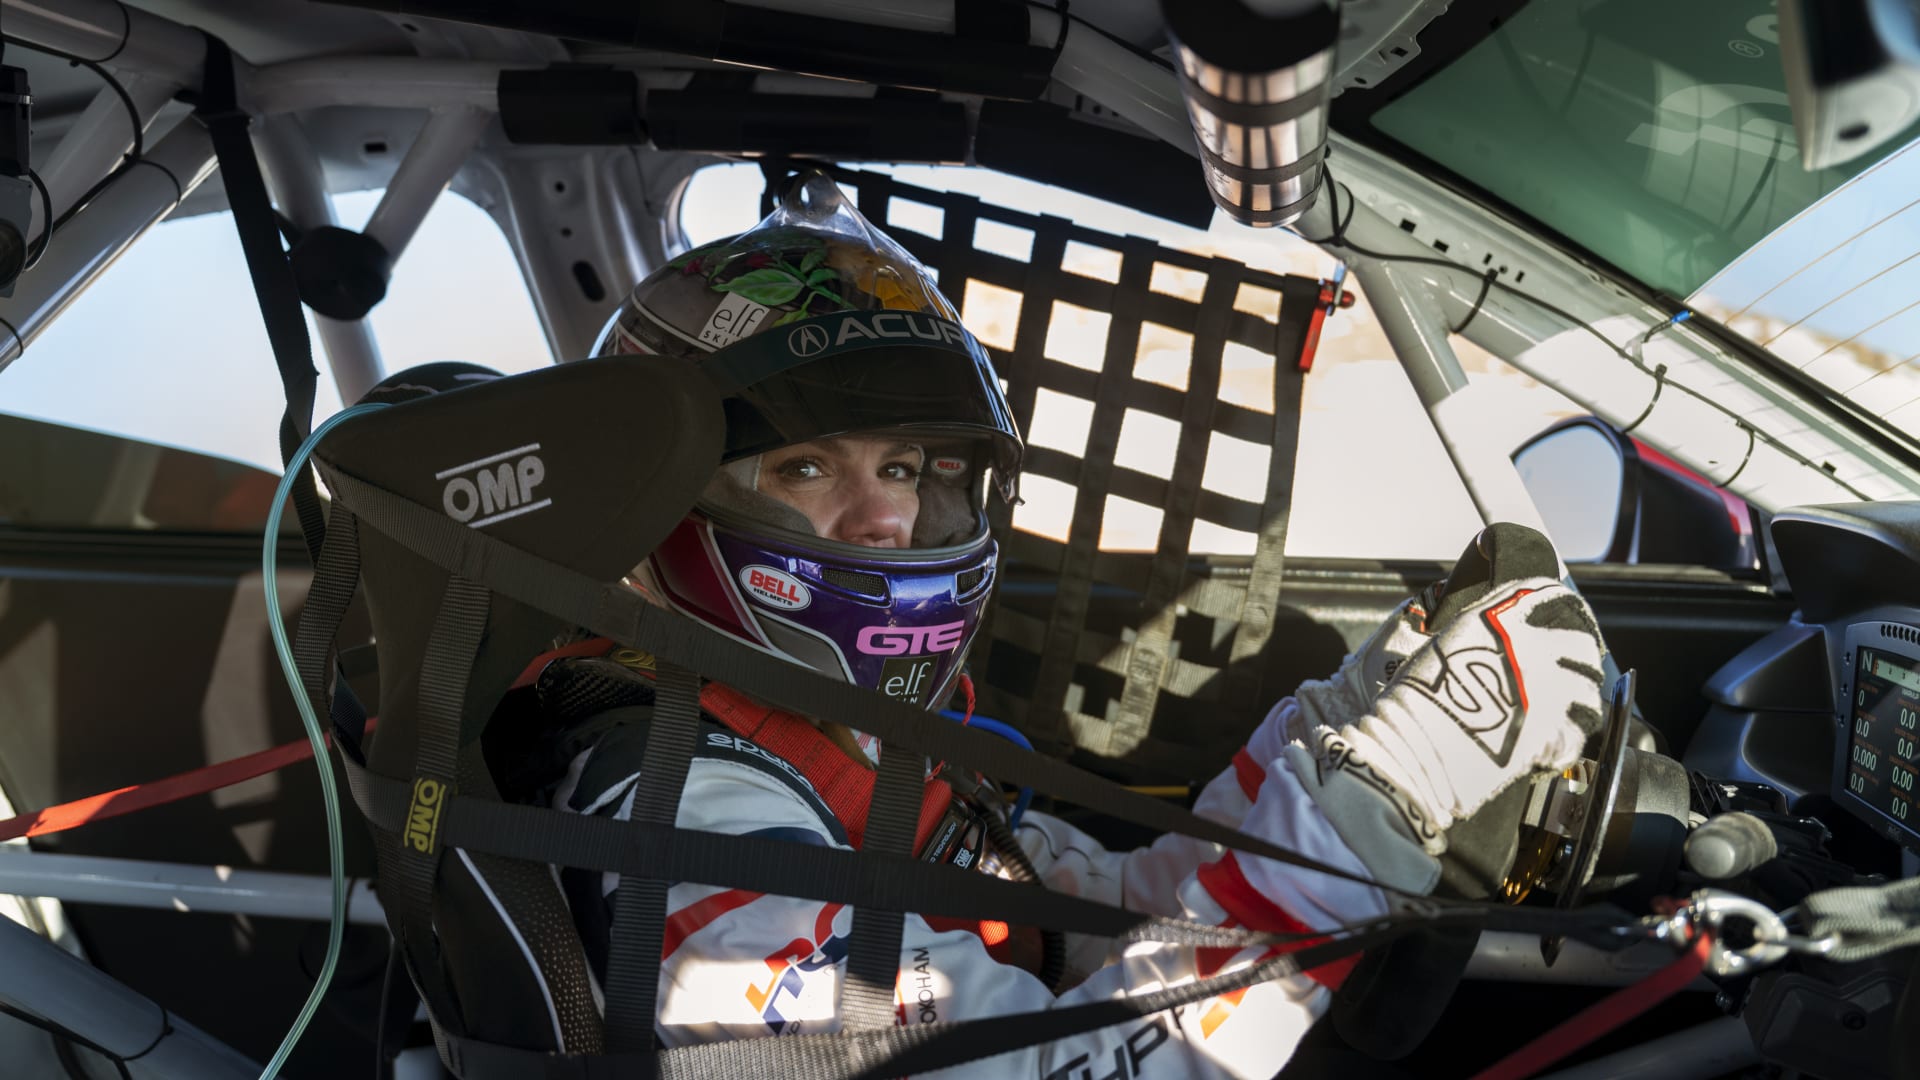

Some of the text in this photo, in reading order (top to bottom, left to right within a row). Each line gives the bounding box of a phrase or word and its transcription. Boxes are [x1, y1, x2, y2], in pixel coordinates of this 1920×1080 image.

[703, 330, 729, 346] SKI
[835, 313, 966, 346] ACUR
[937, 458, 961, 470] BELL
[443, 455, 545, 523] OMP
[750, 569, 801, 603] BELL
[754, 587, 793, 606] HELMETS
[1862, 650, 1873, 673] N
[1858, 689, 1865, 707] 0
[1856, 717, 1870, 738] 0.0
[1900, 707, 1916, 730] 0.0
[1853, 744, 1877, 771] 0.000
[1897, 737, 1913, 760] 0.0
[1850, 772, 1864, 794] 0.0
[1892, 765, 1913, 792] 0.00
[409, 779, 439, 853] OMP
[1892, 797, 1908, 820] 0.0
[956, 848, 972, 868] OMP
[911, 946, 937, 1024] OKOHAM
